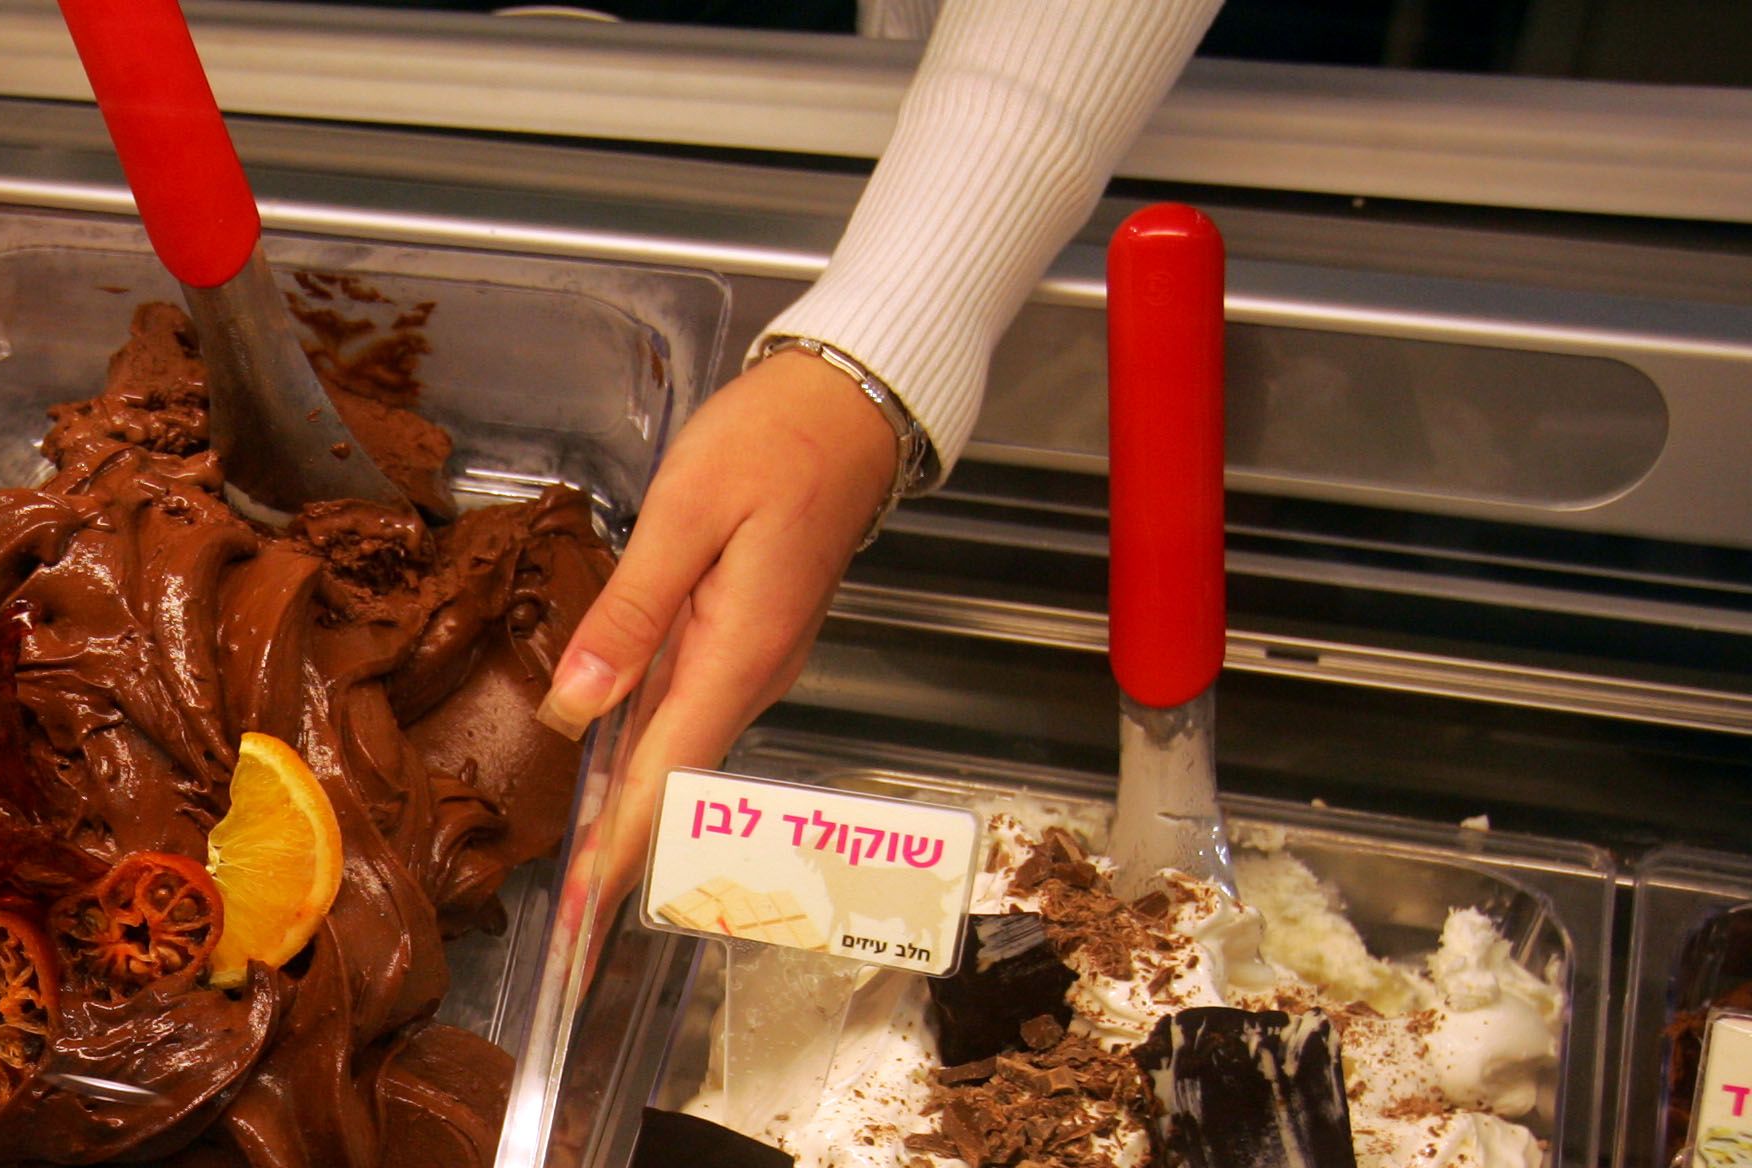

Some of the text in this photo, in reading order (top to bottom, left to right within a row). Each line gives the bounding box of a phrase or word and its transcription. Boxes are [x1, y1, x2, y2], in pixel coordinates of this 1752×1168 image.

[691, 798, 945, 869] שוקולד לבן
[842, 934, 931, 962] חלב עיזים
